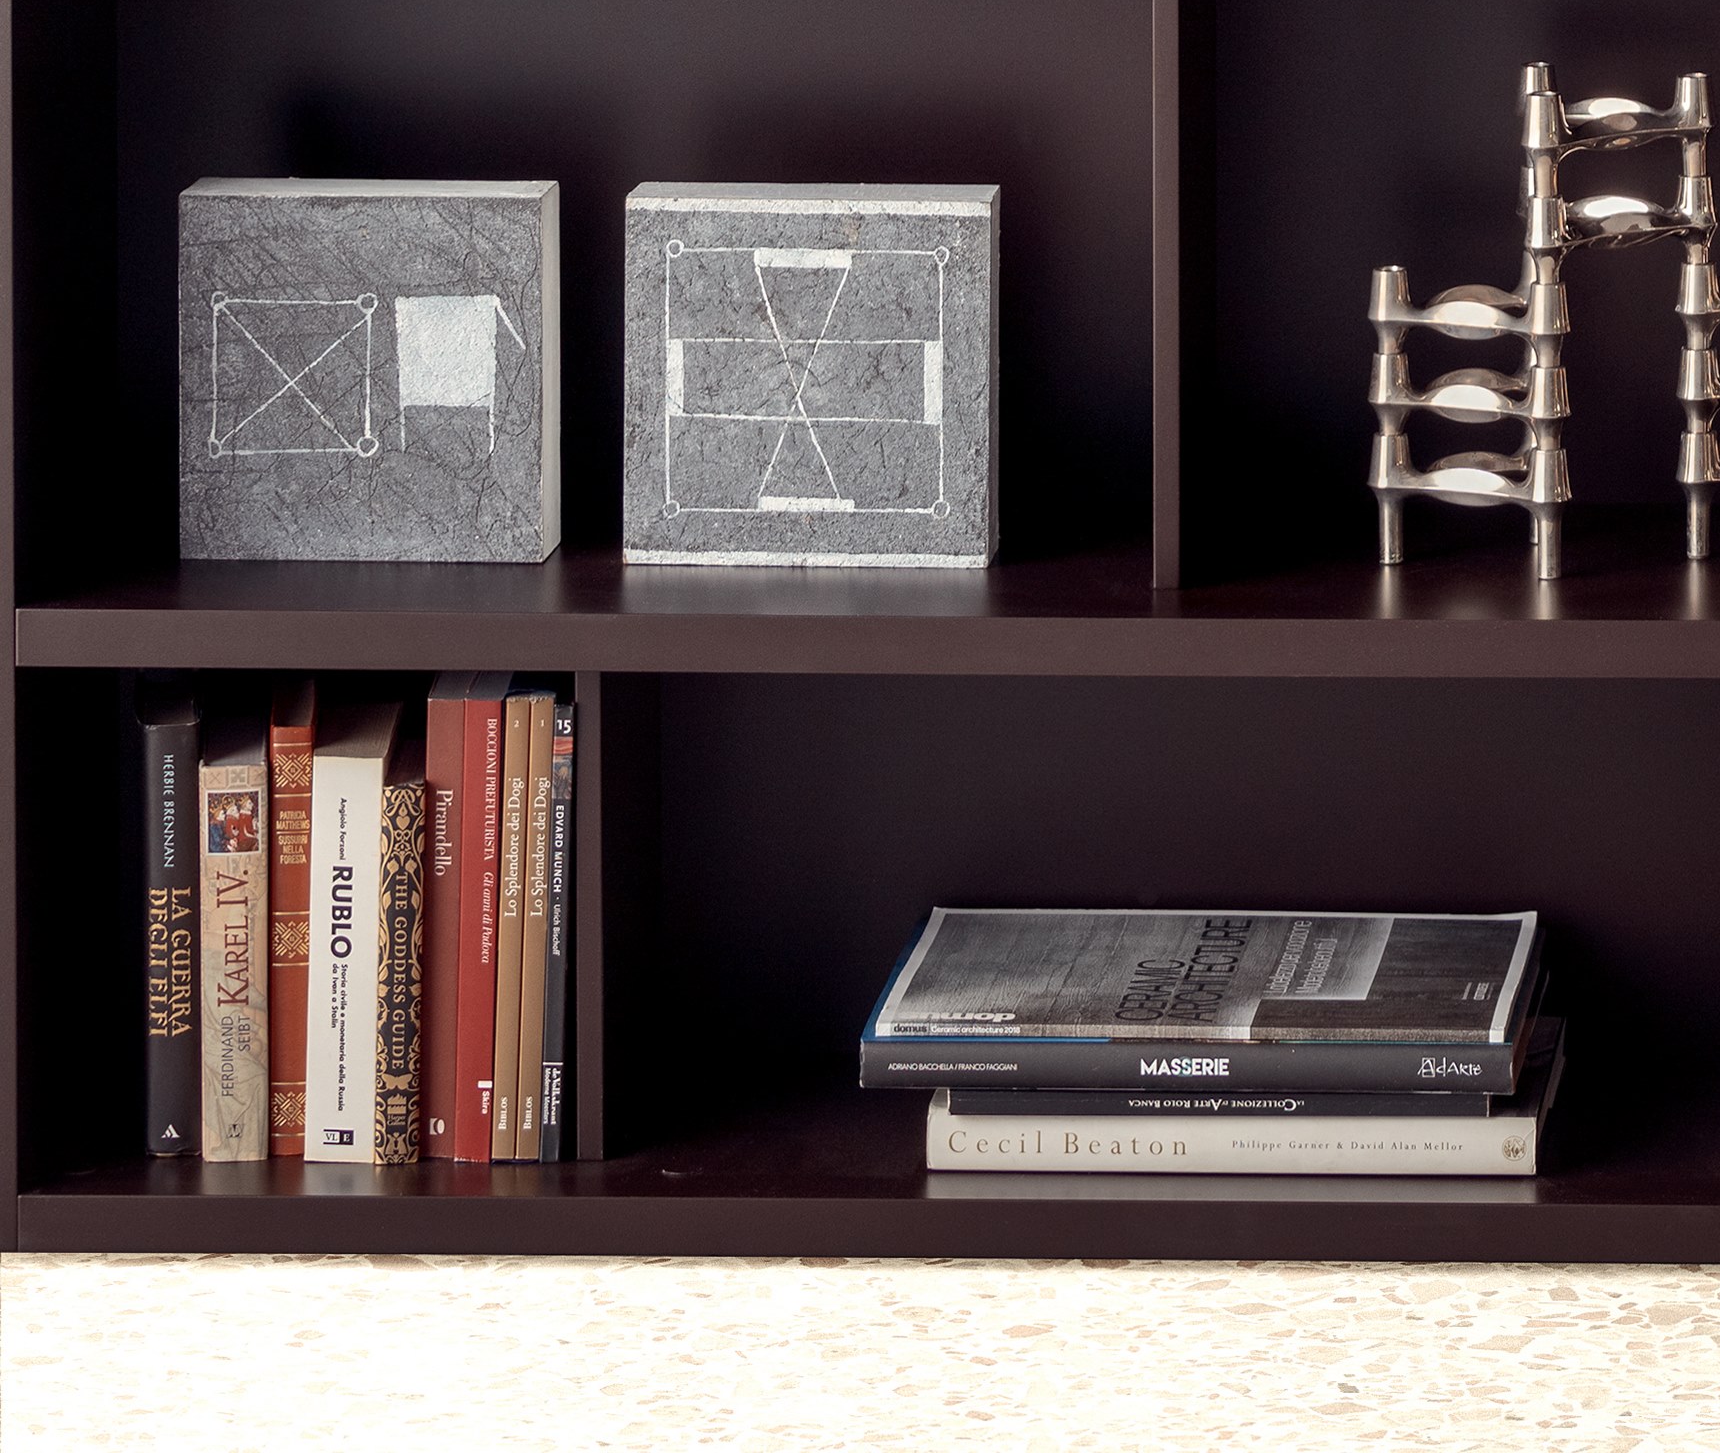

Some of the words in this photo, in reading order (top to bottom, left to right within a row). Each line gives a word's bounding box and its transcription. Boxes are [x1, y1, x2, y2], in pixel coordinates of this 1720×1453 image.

[485, 717, 498, 775] BOCCIONI
[556, 719, 571, 735] 15
[163, 754, 174, 795] HERBIE
[508, 777, 524, 810] Dogi
[535, 776, 550, 810] Dogi
[162, 801, 174, 868] BRENNAN
[275, 820, 311, 831] MATTHEWS
[280, 810, 307, 820] PATRICIA
[434, 788, 454, 877] Pirandello
[483, 776, 497, 862] PREFUTURISTA
[505, 811, 520, 830] dei
[533, 811, 547, 830] dei
[554, 804, 565, 849] EDVARD
[280, 853, 307, 864] FORESTA
[282, 844, 304, 854] NELLA
[504, 832, 522, 897] Splendore
[531, 832, 548, 897] Splendore
[395, 871, 408, 911] THE
[553, 851, 564, 893] MUNCH
[171, 887, 192, 922] LA
[330, 866, 354, 959] RUBLO
[504, 898, 517, 918] Lo
[530, 897, 543, 917] Lo
[148, 887, 168, 966] DEGLI
[481, 922, 493, 964] Padova
[218, 915, 250, 1008] KAREL
[393, 916, 407, 1004] GODDESS
[1166, 918, 1253, 1024] ARCHITECTURE
[170, 929, 193, 1037] GUERRA
[1114, 959, 1186, 1022] CERAMIC
[148, 976, 168, 1037] ELFI
[392, 1009, 406, 1070] GUIDE
[893, 1024, 928, 1033] domus
[930, 1026, 960, 1034] Ceramic
[961, 1026, 1004, 1034] architecture
[222, 1015, 234, 1097] FERDINAND
[238, 1015, 250, 1051] SEIBT
[887, 1063, 918, 1071] ADRIANO
[958, 1063, 985, 1071] FRANCO
[986, 1063, 1018, 1071] FAGGIANI
[1140, 1057, 1230, 1077] MASSERIE
[481, 1090, 491, 1115] Skira
[497, 1096, 508, 1131] BIBLOS
[522, 1096, 533, 1130] BIBLOS
[948, 1130, 1042, 1154] Cecil
[1063, 1131, 1188, 1156] Beaton
[1232, 1139, 1282, 1152] Philippe
[1289, 1140, 1330, 1150] Garner
[1350, 1141, 1384, 1150] David
[1391, 1141, 1417, 1150] Alan
[1423, 1141, 1464, 1151] Mellor
